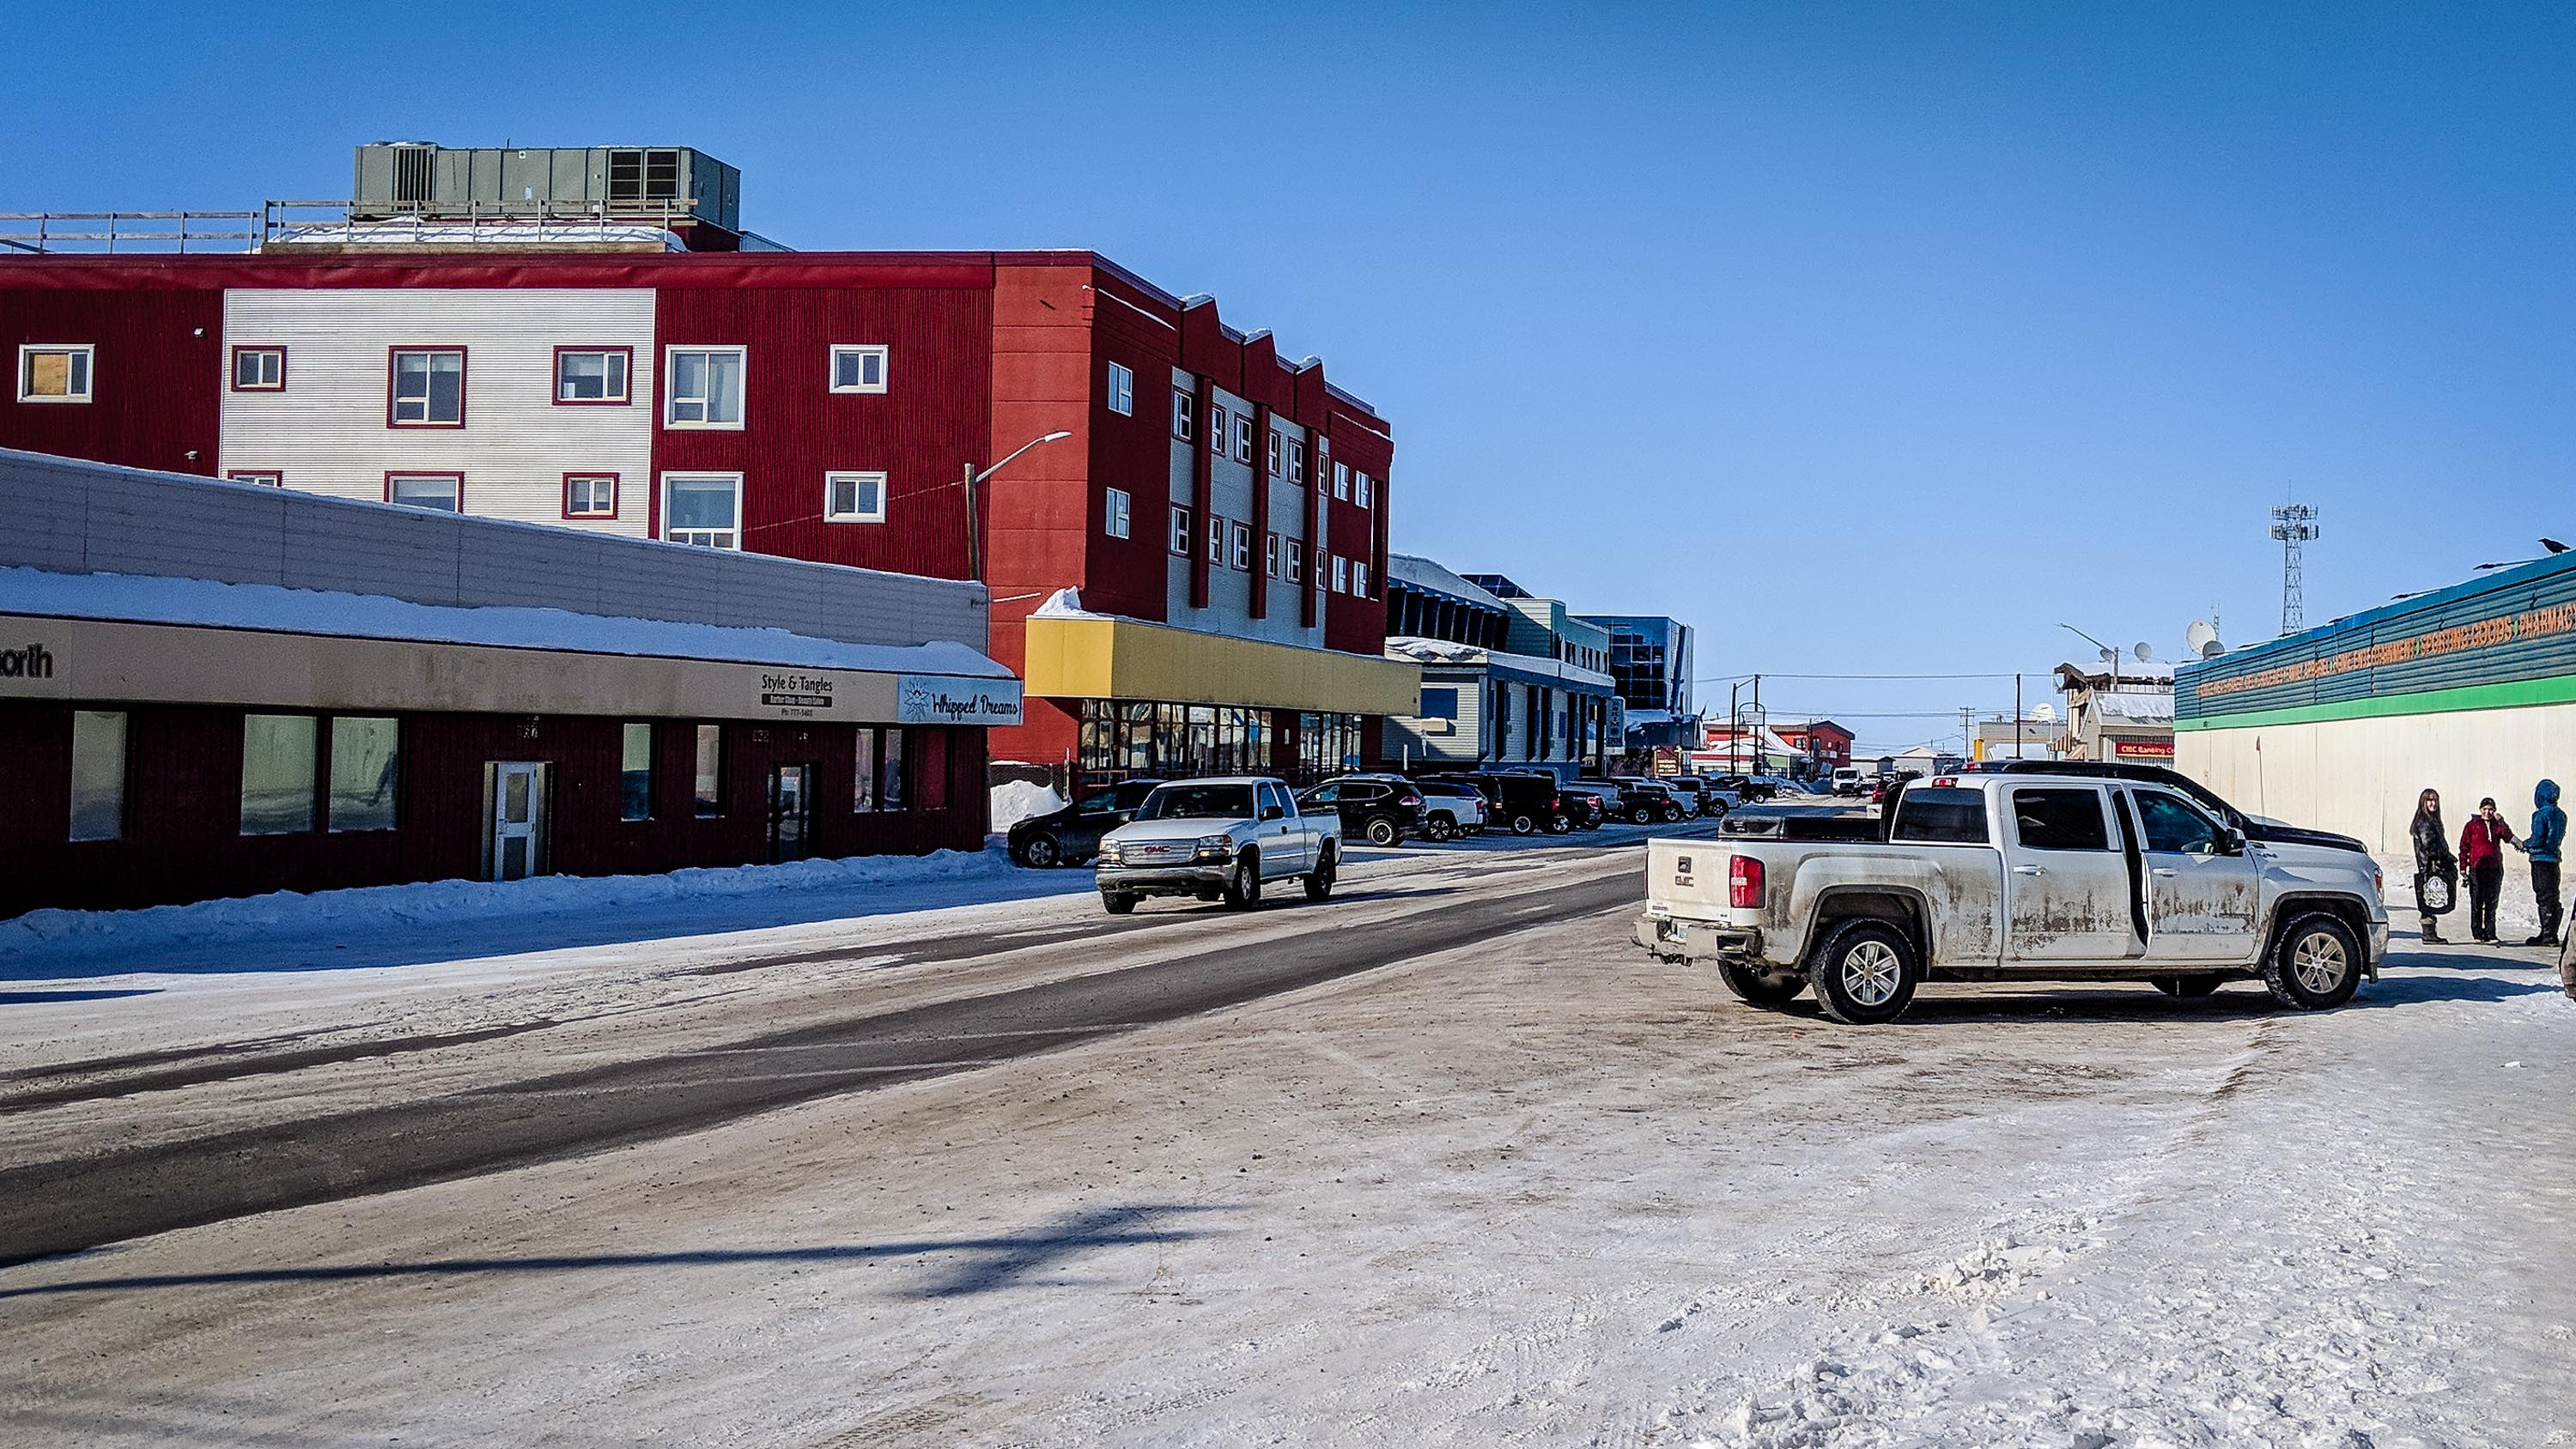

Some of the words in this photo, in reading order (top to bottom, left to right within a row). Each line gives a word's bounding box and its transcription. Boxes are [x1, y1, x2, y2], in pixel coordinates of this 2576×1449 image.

[2421, 626, 2468, 658] SPORTING
[2471, 615, 2512, 647] GOODS
[762, 674, 786, 692] Style
[788, 675, 797, 690] &
[799, 676, 833, 694] Tangles
[932, 694, 977, 721] Whipped
[980, 694, 1018, 715] Dreams
